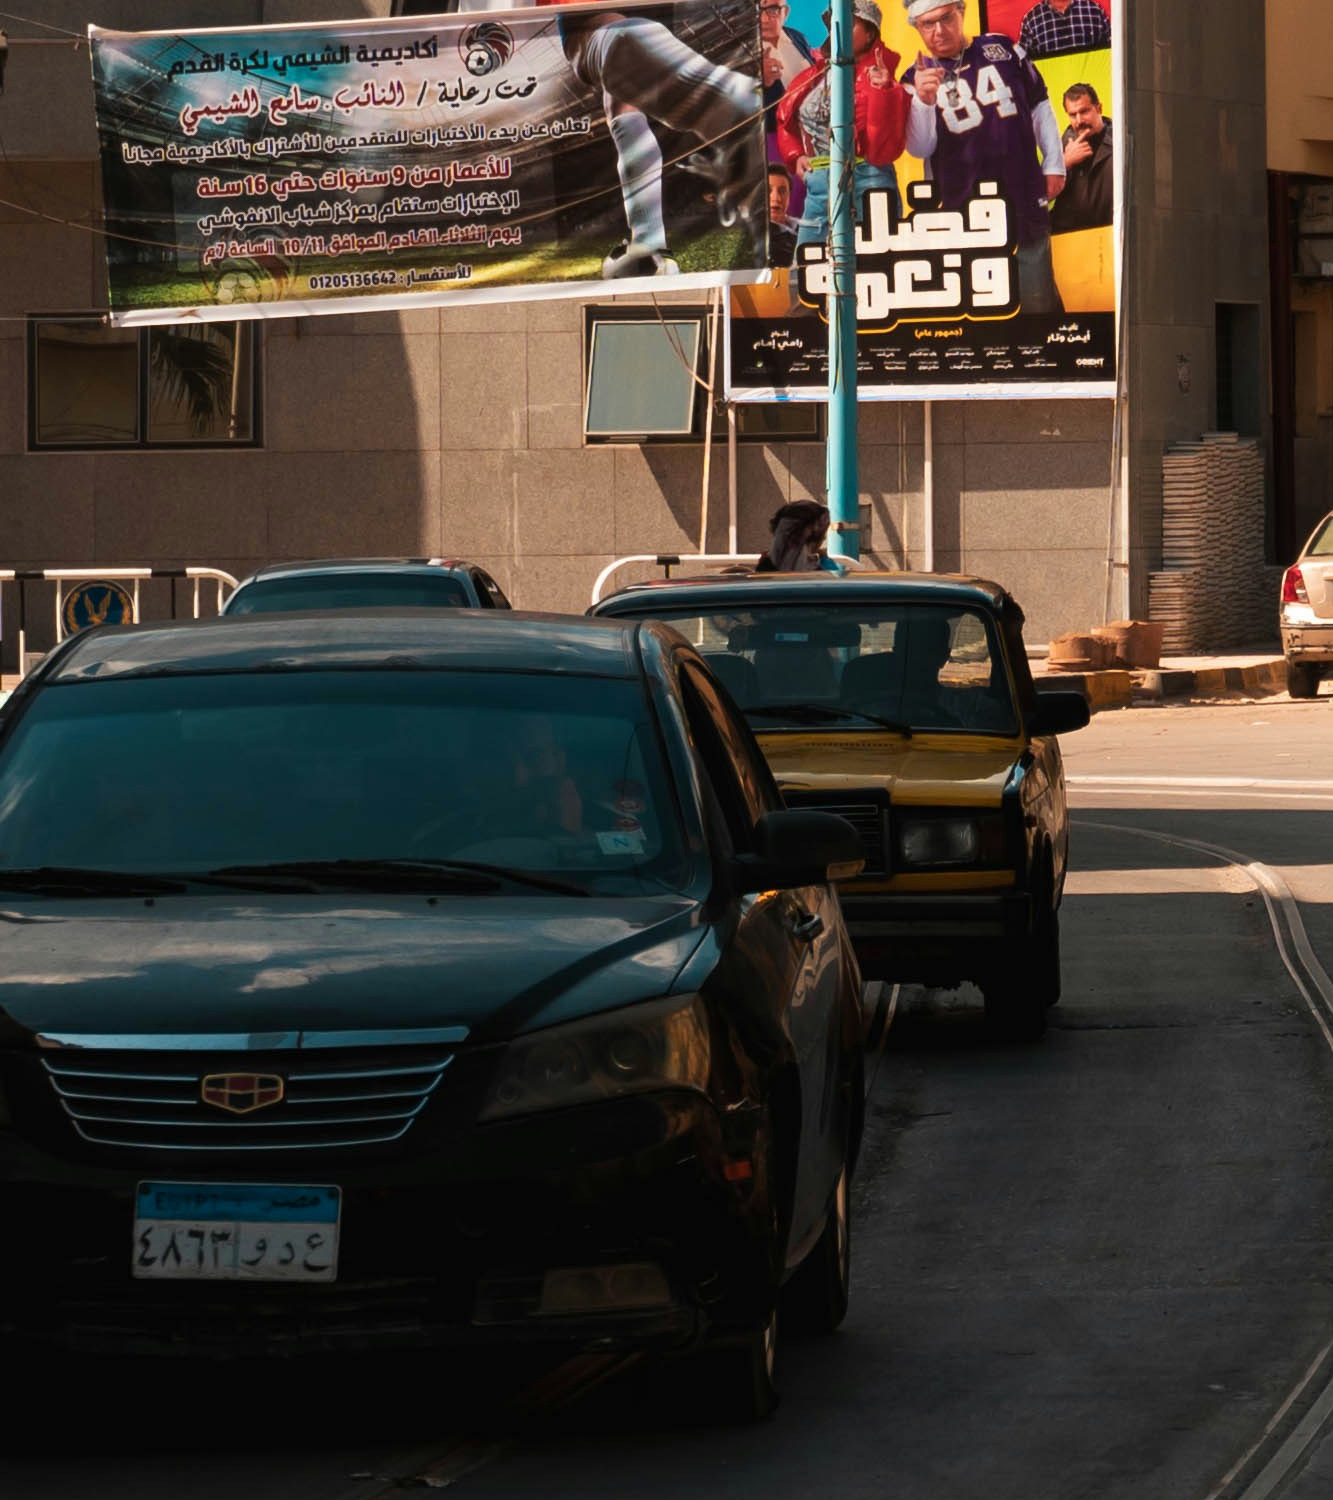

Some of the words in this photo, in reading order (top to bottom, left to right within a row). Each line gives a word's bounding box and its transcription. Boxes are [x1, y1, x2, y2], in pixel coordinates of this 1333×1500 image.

[229, 50, 268, 75] لكرة
[273, 43, 350, 76] الشيمي
[356, 35, 438, 67] أكاديمية
[168, 53, 225, 83] القدم
[334, 81, 405, 113] النائب
[438, 76, 491, 108] رعاية
[495, 76, 538, 99] تحت
[936, 64, 1019, 135] 84
[181, 87, 260, 135] الشيمي
[269, 85, 320, 124] سامح
[488, 126, 517, 142] بدء
[522, 123, 547, 139] عن
[550, 117, 590, 138] تعلن
[324, 129, 409, 154] للمتقدمين
[244, 173, 269, 195] 16
[319, 167, 389, 193] سنوات
[391, 165, 407, 186] 9
[409, 165, 442, 188] من
[444, 154, 511, 188] للأعمار
[197, 175, 243, 197] سنة
[284, 200, 333, 227] شباب
[333, 198, 377, 224] بمركز
[378, 196, 441, 222] ستقام
[855, 182, 1008, 254] فضل
[228, 239, 275, 258] الساعة
[325, 231, 386, 255] الموافق
[387, 227, 438, 254] القادم
[488, 226, 522, 247] يوم
[310, 271, 397, 291] 01205136642
